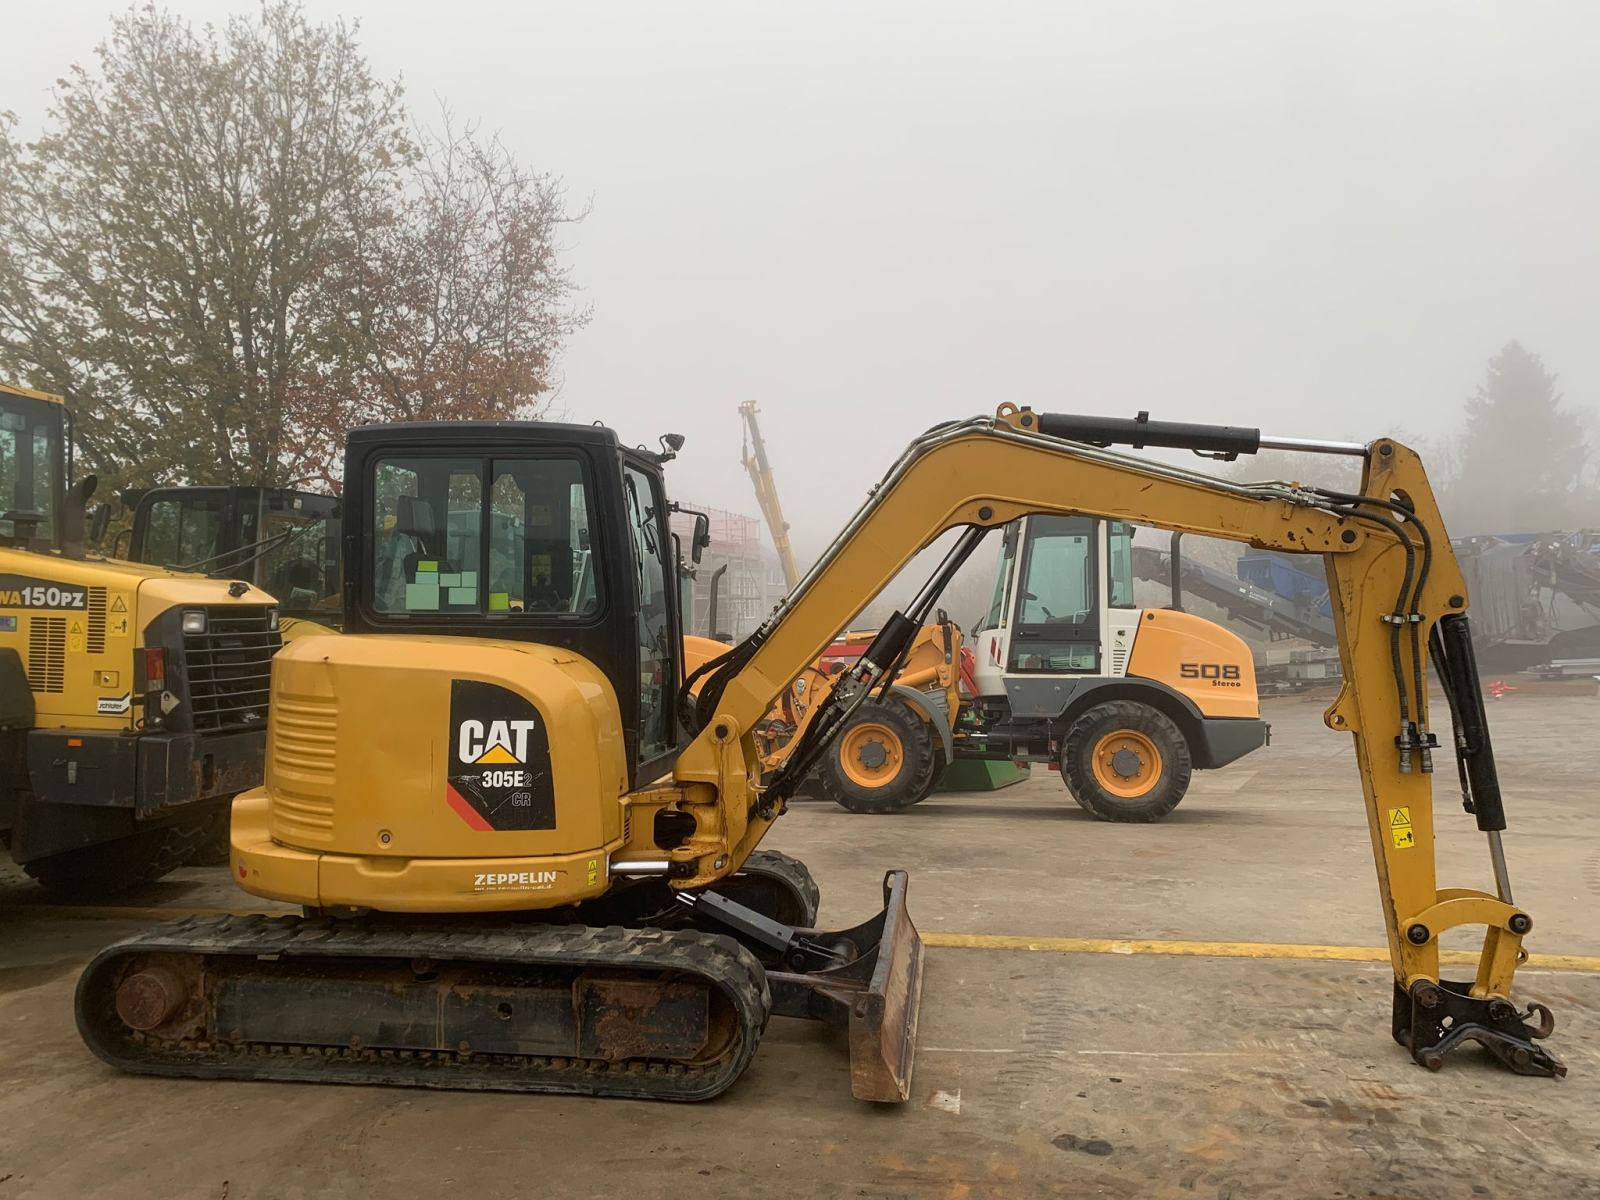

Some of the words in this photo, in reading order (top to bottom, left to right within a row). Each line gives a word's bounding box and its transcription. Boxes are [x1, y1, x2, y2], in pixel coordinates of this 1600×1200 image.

[1180, 663, 1241, 680] 508
[1211, 679, 1241, 688] Stereo
[458, 719, 535, 764] CAT
[482, 770, 533, 788] 305E2
[511, 792, 532, 807] CR
[474, 871, 557, 886] ZEPPELIN
